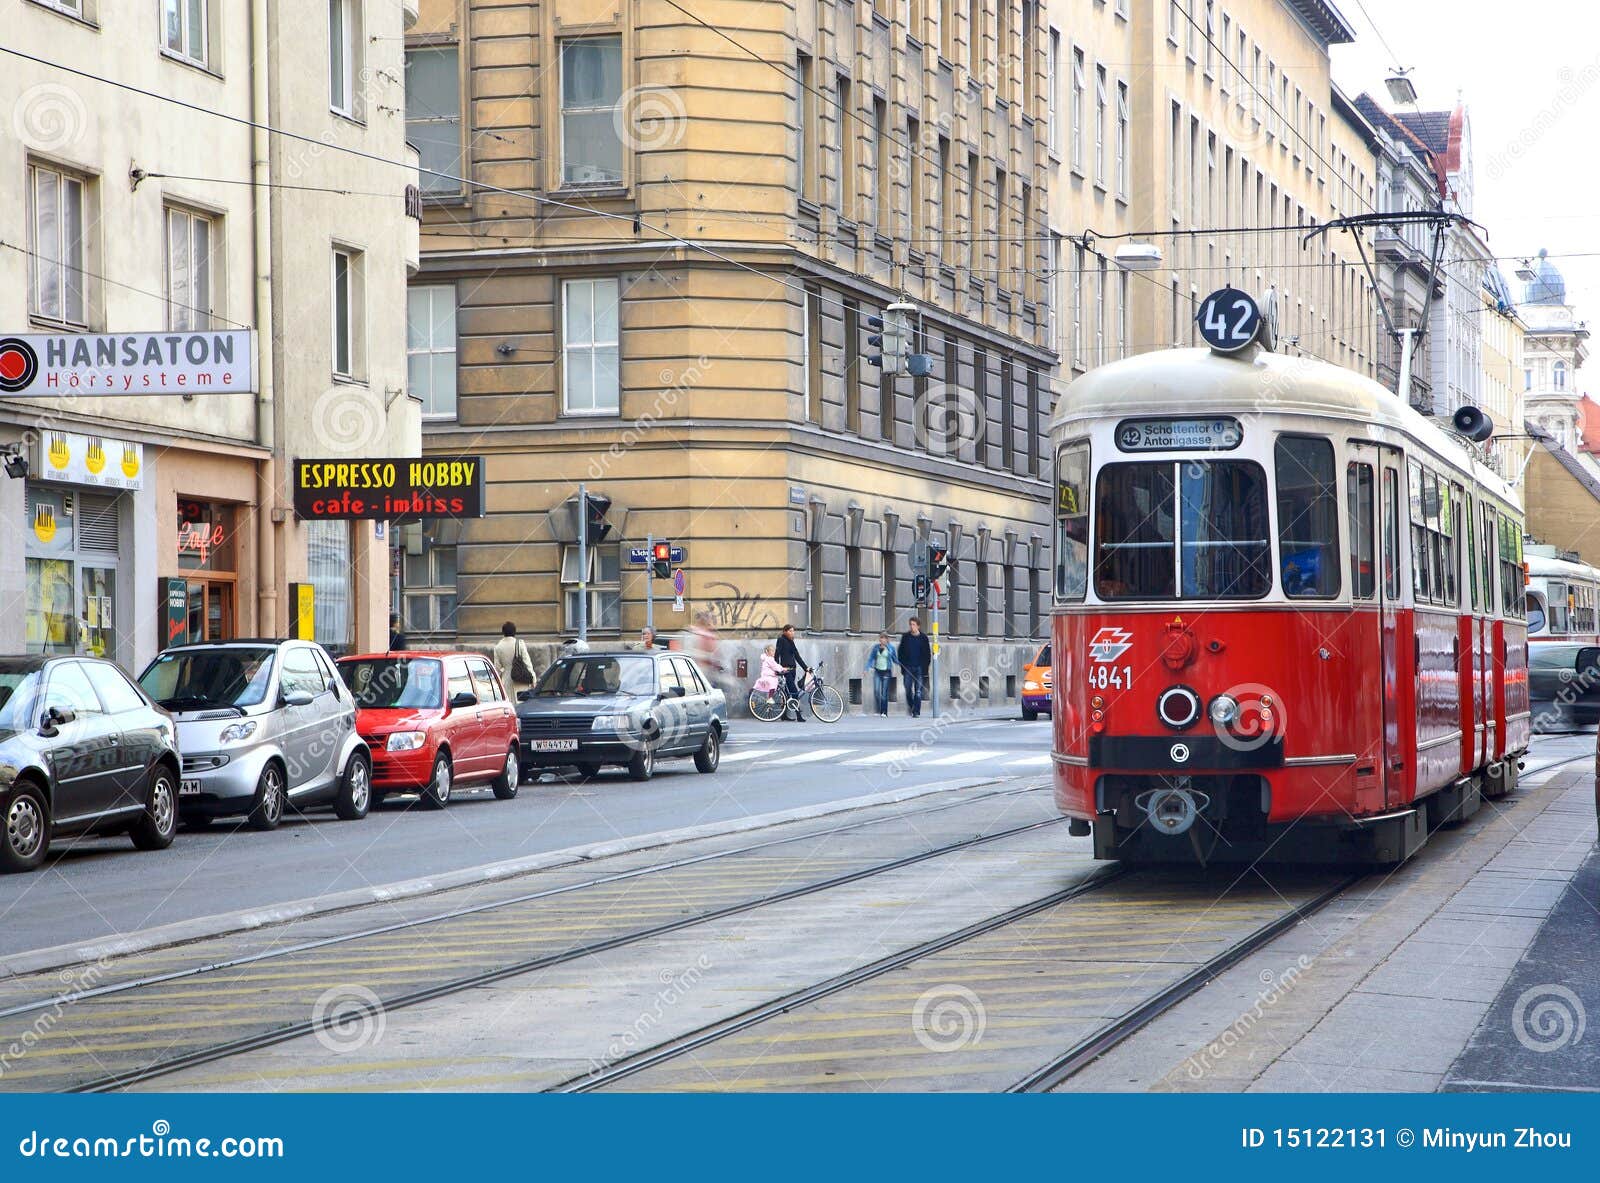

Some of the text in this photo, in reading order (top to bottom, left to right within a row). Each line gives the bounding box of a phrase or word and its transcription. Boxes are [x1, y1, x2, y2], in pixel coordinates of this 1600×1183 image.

[1204, 299, 1253, 340] 42
[46, 334, 234, 367] HANSATON
[46, 371, 233, 390] Hörsysteme
[1121, 430, 1141, 443] 42
[300, 462, 475, 488] ESPRESSO HOBBY
[311, 490, 365, 514] cafe
[384, 491, 465, 513] imbiss
[1088, 665, 1132, 690] 4841
